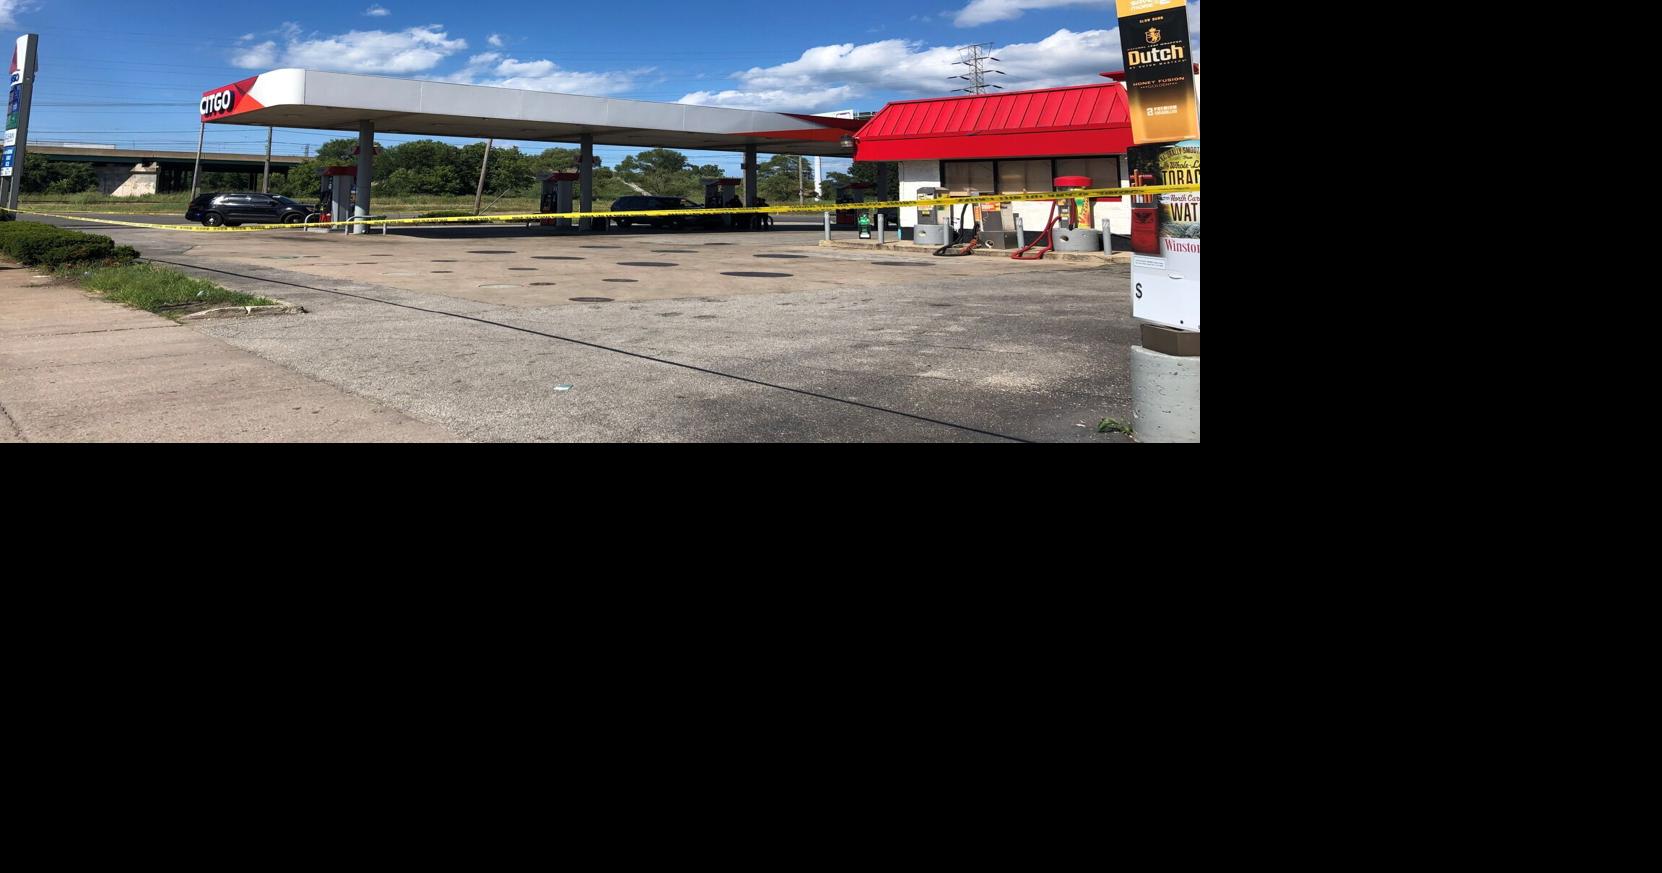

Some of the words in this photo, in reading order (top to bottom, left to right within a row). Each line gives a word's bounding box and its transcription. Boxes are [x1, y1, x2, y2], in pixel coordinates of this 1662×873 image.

[1127, 44, 1184, 66] Dutch
[200, 90, 231, 115] CITGO
[1170, 194, 1187, 202] North
[1170, 202, 1198, 222] WAT
